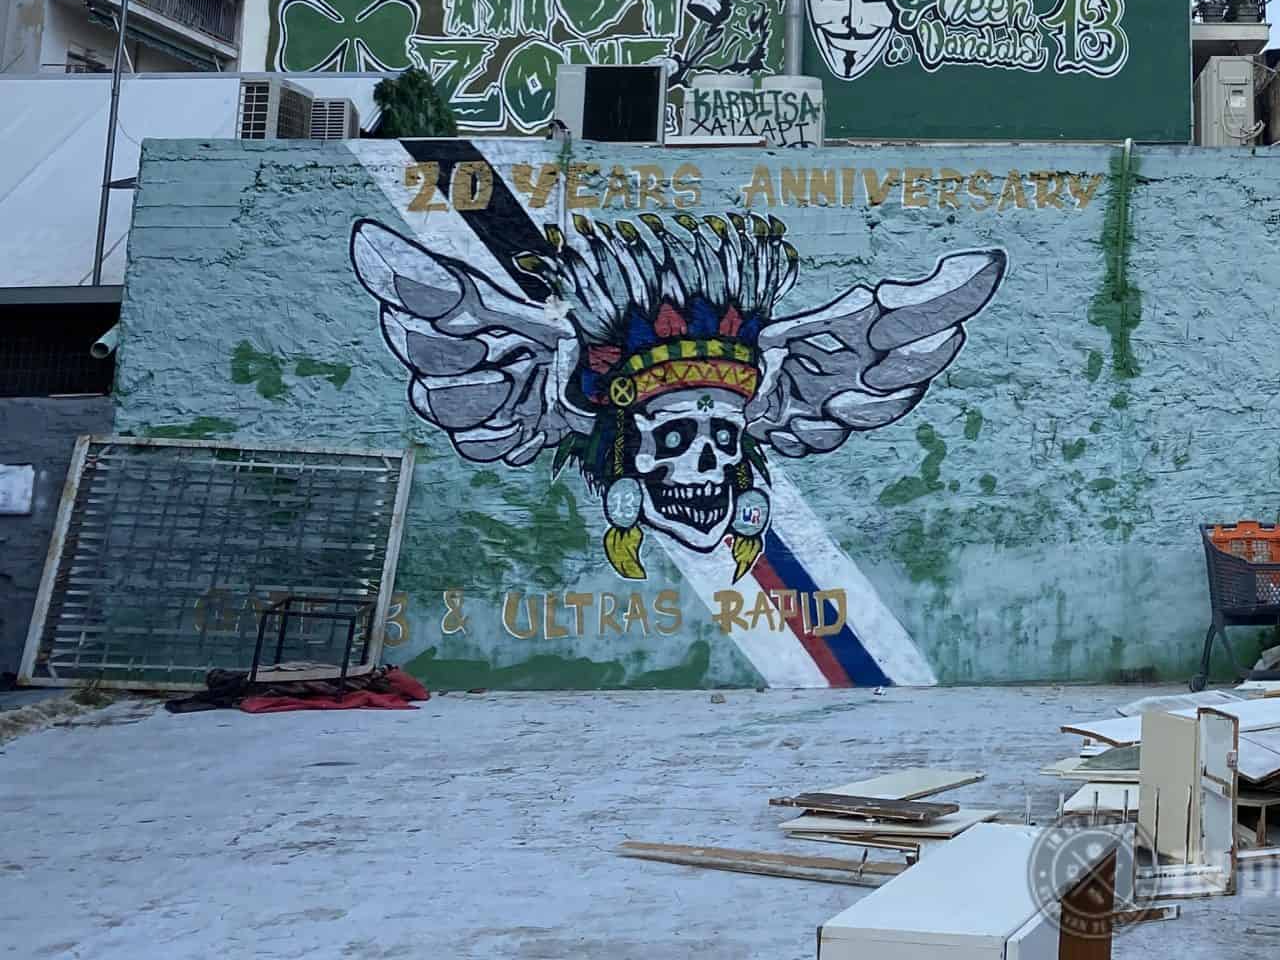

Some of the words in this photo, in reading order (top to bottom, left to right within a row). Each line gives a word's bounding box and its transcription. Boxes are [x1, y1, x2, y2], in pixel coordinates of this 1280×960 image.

[914, 16, 1047, 70] Vandals
[691, 88, 820, 123] KARDITSA
[405, 161, 494, 212] 20
[512, 161, 701, 209] YEARS
[743, 164, 1103, 210] ANNIVERSARY
[502, 589, 682, 640] ULTRAS
[712, 587, 848, 637] RAPID
